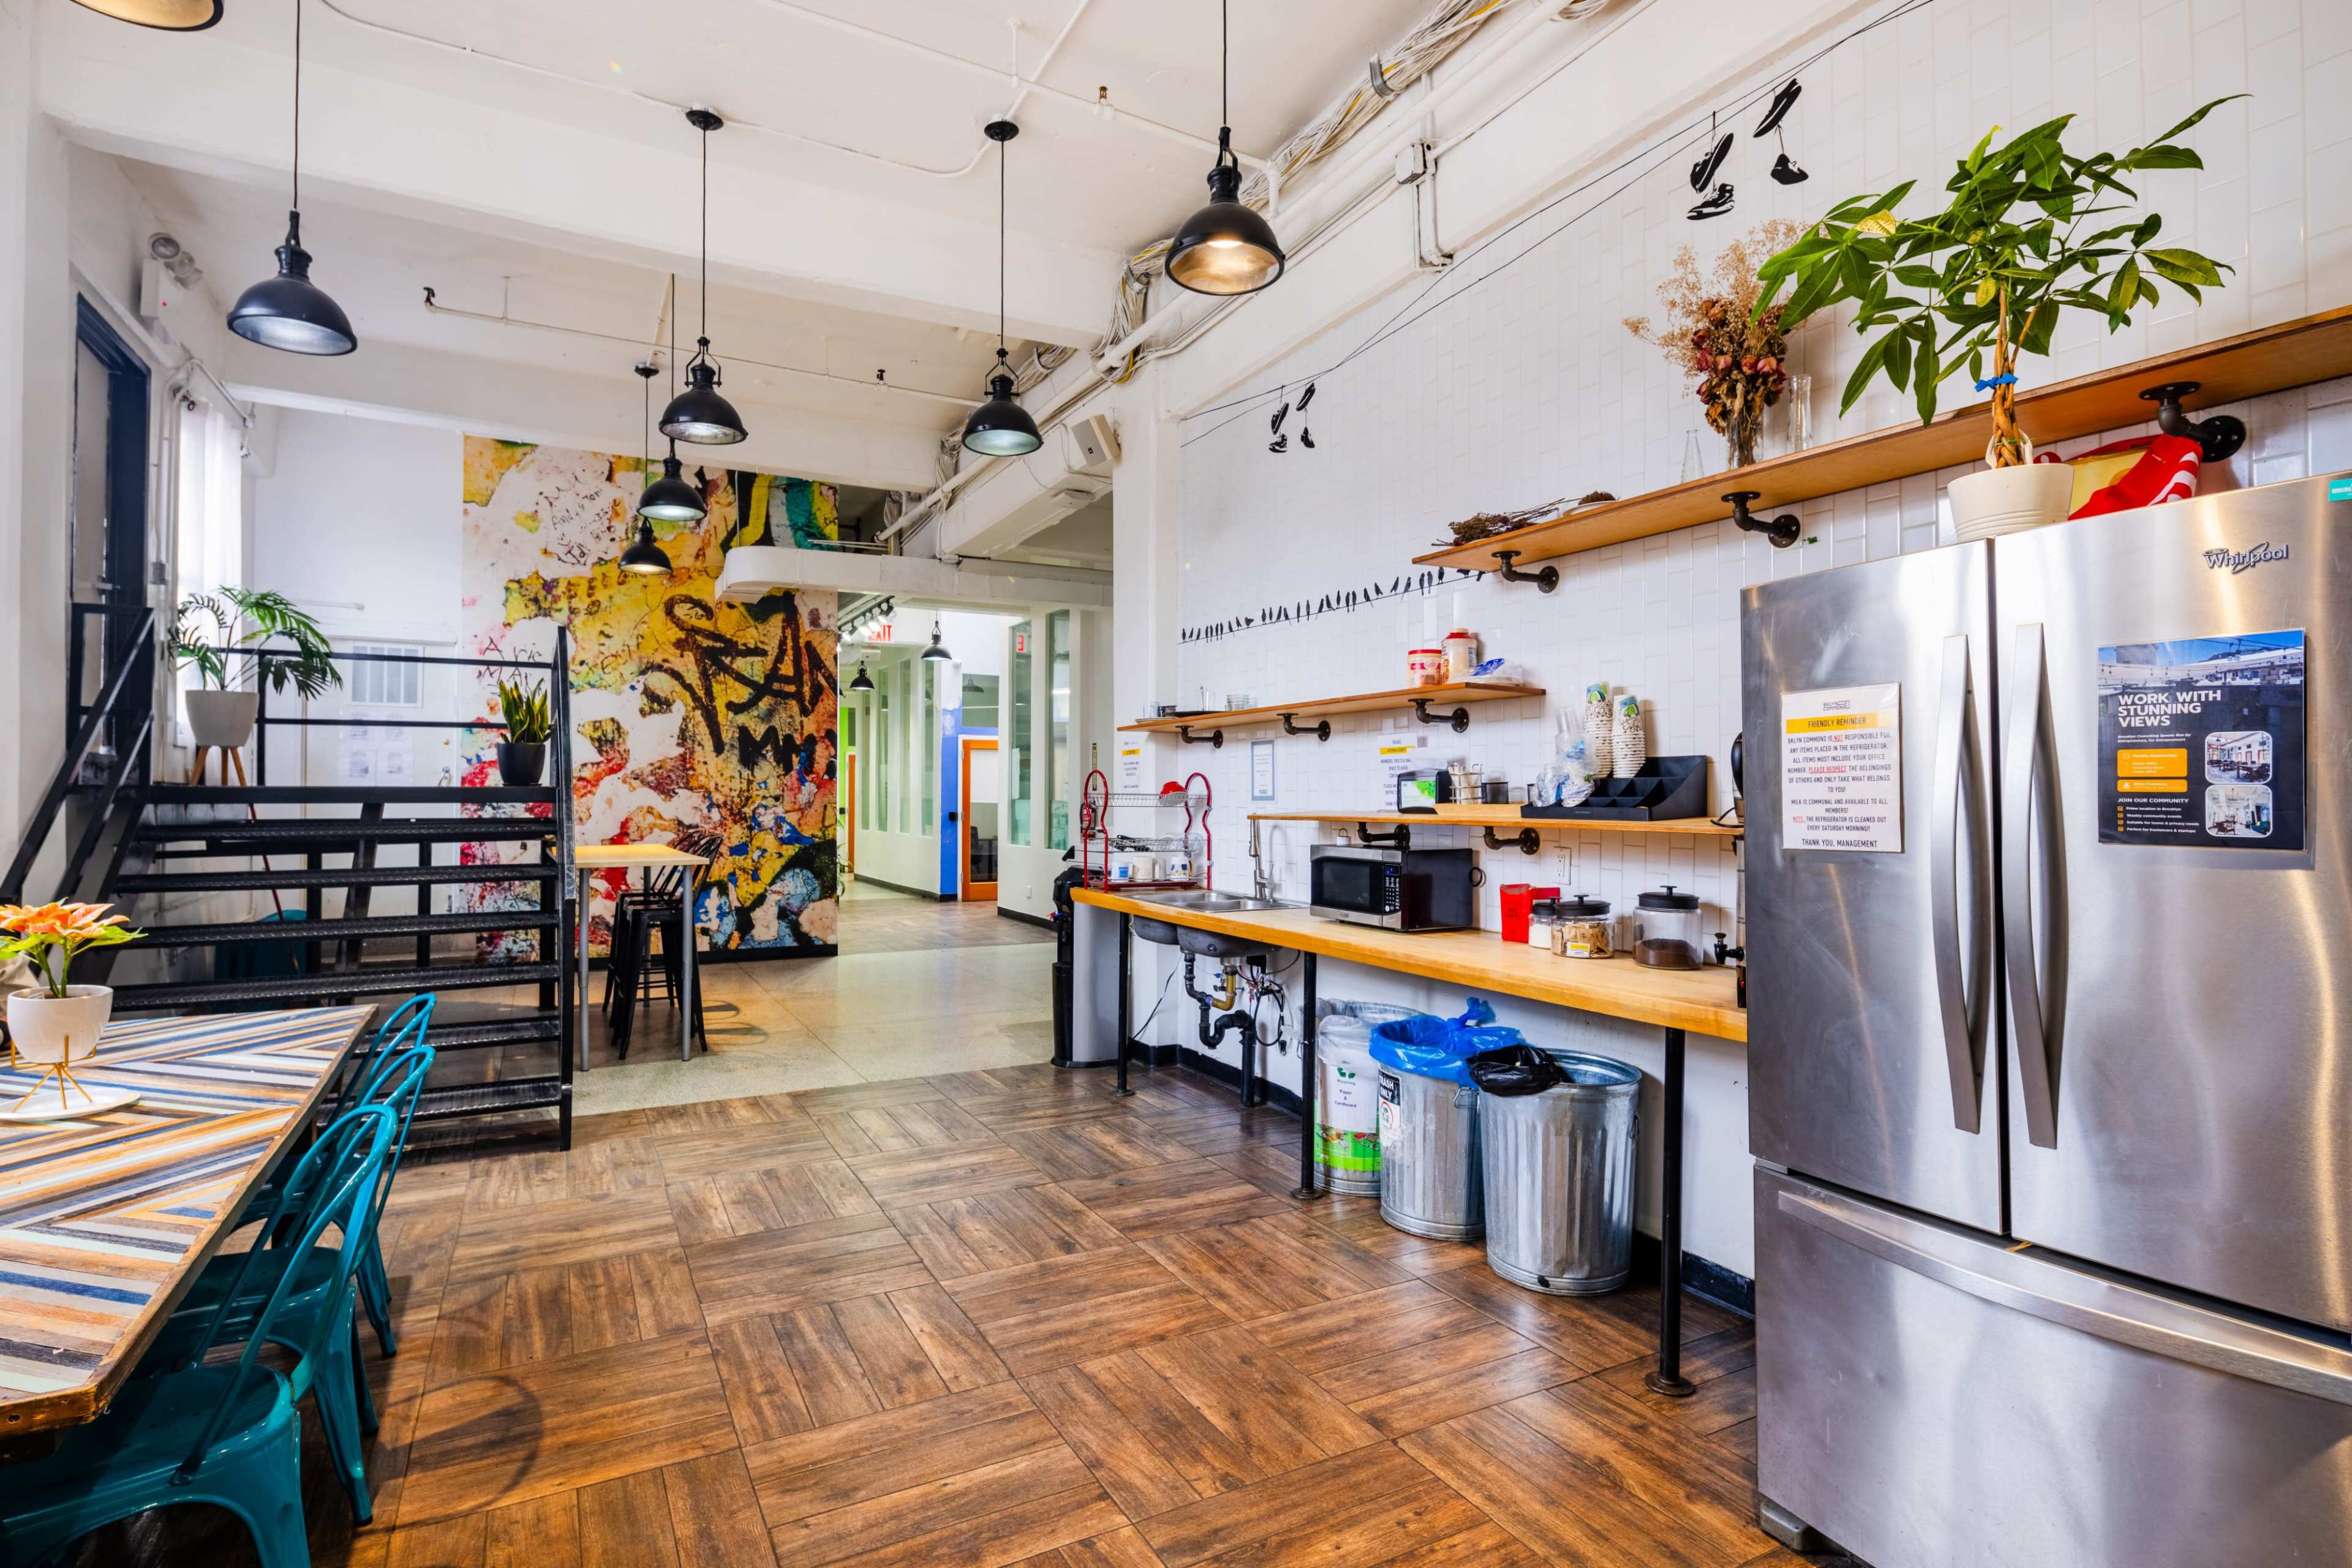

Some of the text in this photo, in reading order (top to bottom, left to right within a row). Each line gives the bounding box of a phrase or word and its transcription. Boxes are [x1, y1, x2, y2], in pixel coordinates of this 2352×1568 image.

[2203, 542, 2289, 572] Whirlpool
[2118, 690, 2222, 705] WORK WITH
[2118, 703, 2201, 717] STUNNING
[1808, 717, 1866, 728] FRIENDLY REMINDER
[2118, 715, 2171, 728] VIEWS
[1844, 732, 1879, 741] RESPONSIBLE
